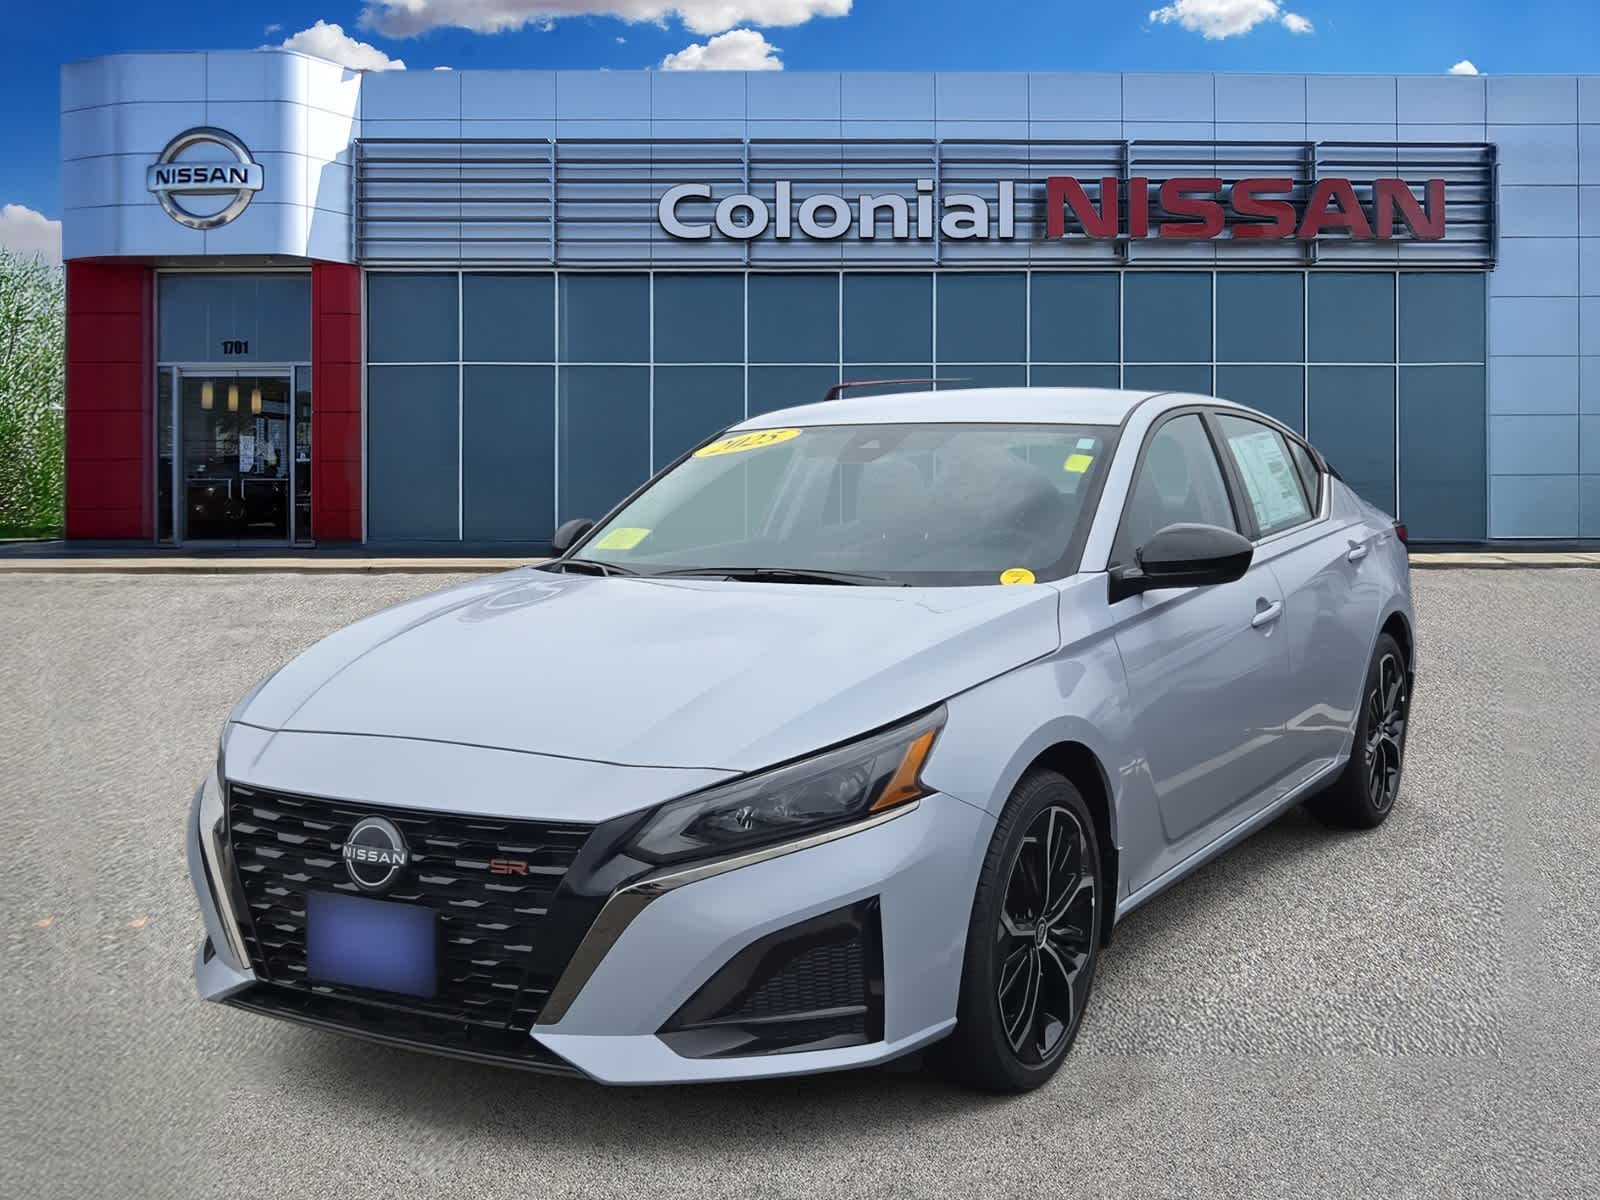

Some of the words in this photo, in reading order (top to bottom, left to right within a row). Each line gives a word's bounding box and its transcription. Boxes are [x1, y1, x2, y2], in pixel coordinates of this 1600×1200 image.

[155, 167, 248, 185] NISSAN
[657, 178, 1015, 241] Colonial
[1046, 176, 1446, 240] NISSAN
[222, 340, 249, 355] 1701
[342, 845, 405, 865] NISSAN
[490, 858, 529, 876] SR
